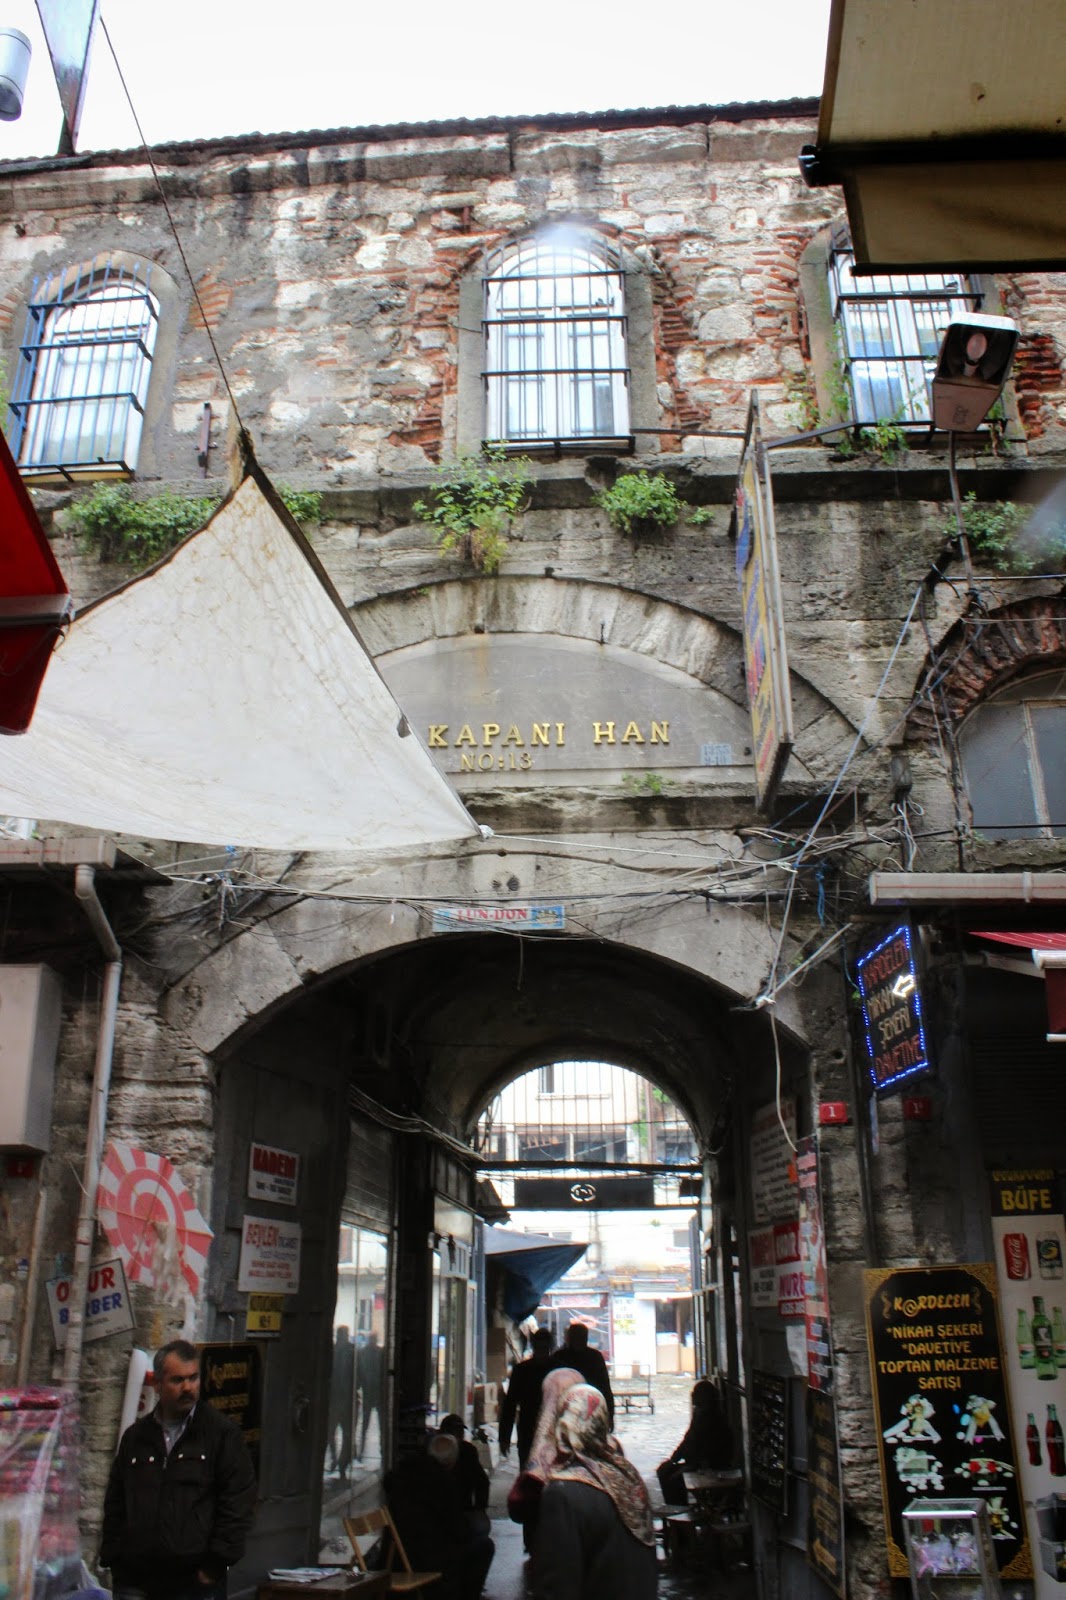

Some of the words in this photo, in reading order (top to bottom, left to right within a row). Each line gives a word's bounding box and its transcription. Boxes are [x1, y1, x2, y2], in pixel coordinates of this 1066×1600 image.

[428, 722, 566, 748] KAPANI
[592, 721, 670, 745] HAN
[460, 752, 533, 771] NO:13
[829, 1106, 836, 1118] 1
[1001, 1184, 1053, 1212] BÜFE
[56, 1267, 115, 1303] OUR
[936, 1321, 984, 1340] ŞEKERİ
[878, 1358, 932, 1375] TOPTAN
[934, 1356, 999, 1373] MALZEME
[917, 1375, 962, 1392] SATIŞI
